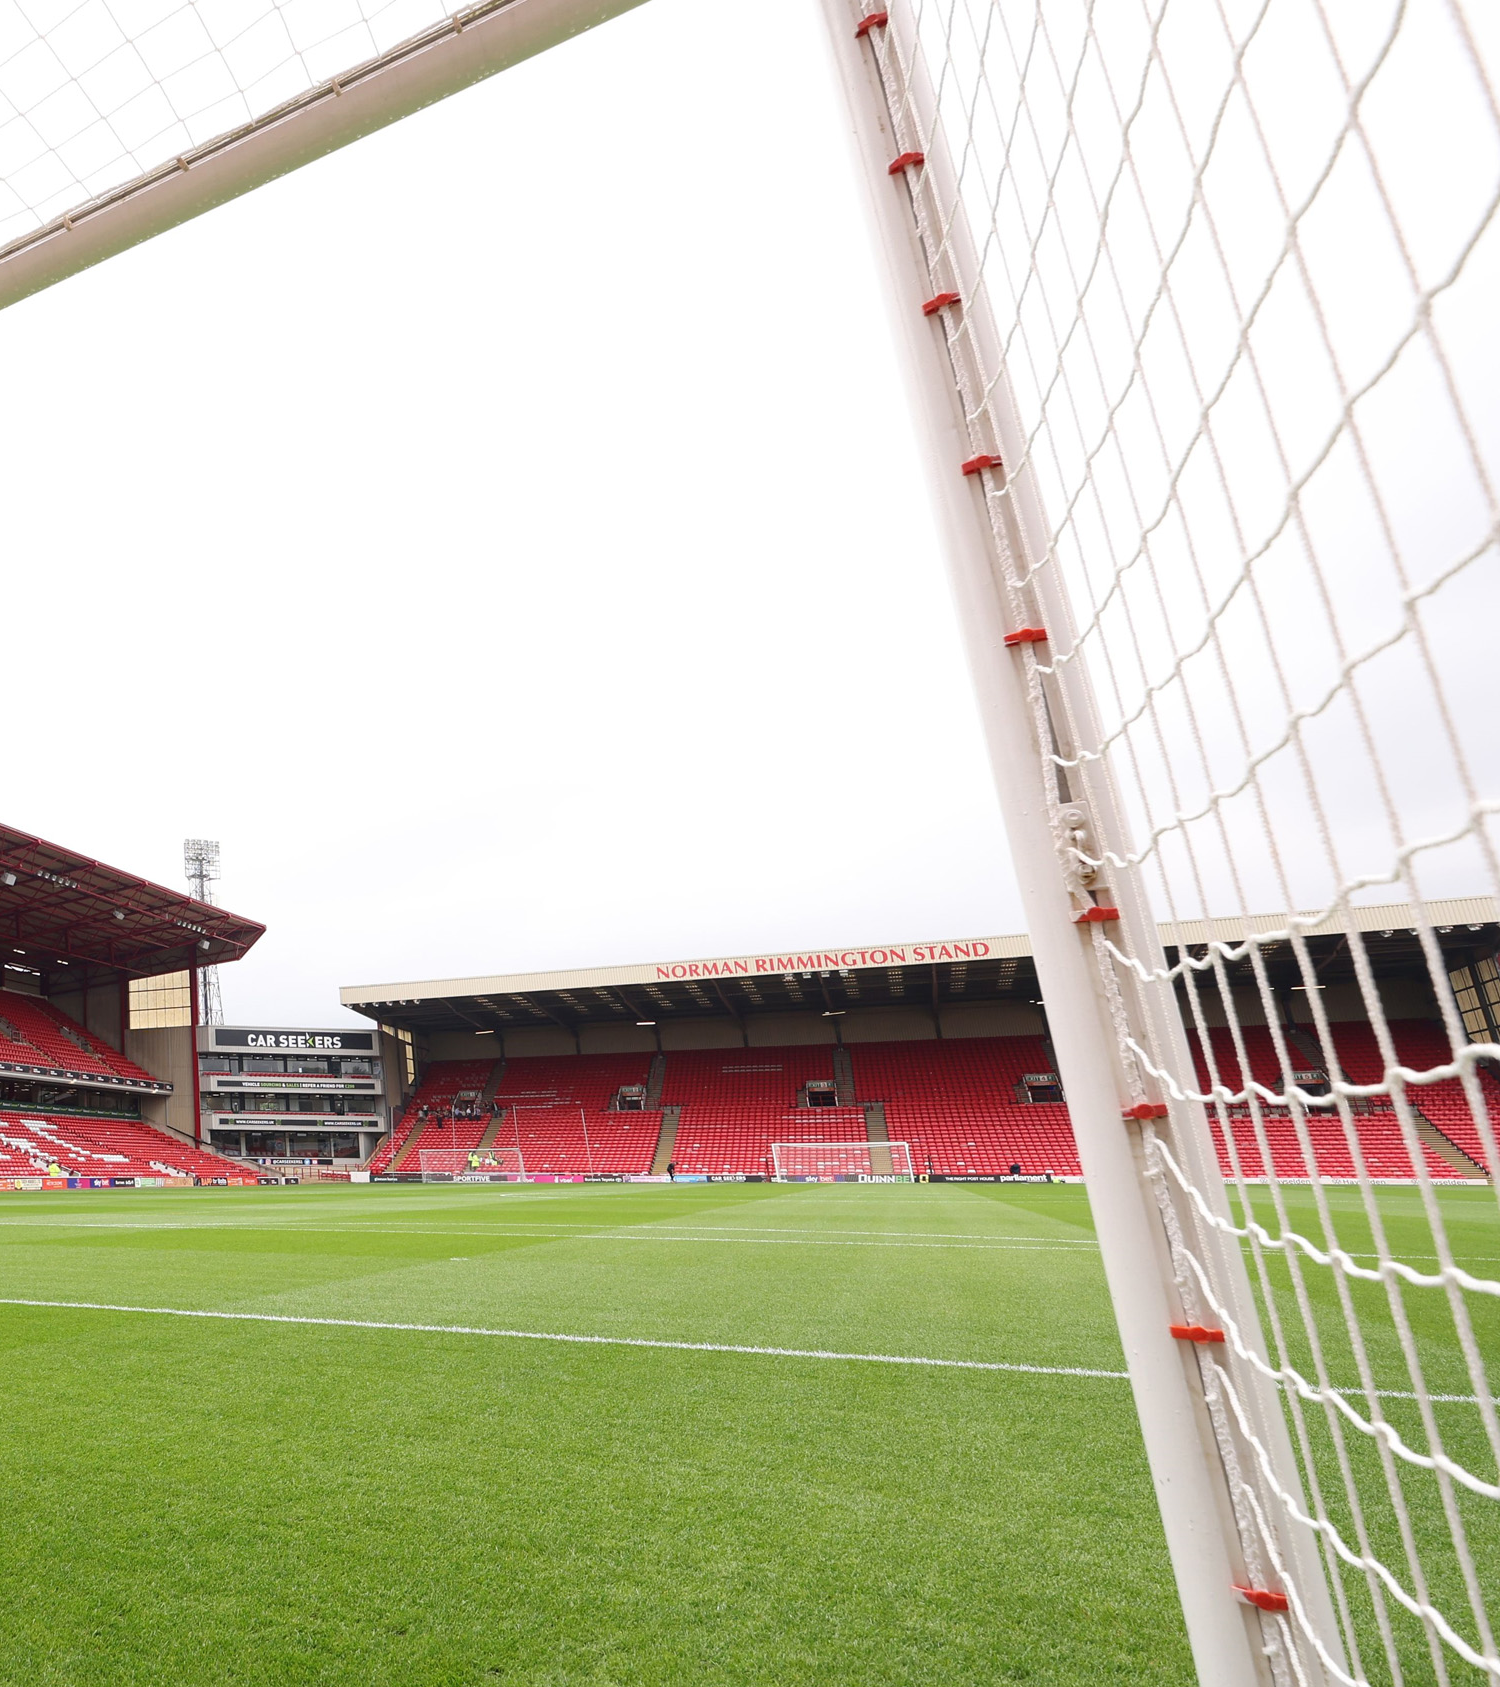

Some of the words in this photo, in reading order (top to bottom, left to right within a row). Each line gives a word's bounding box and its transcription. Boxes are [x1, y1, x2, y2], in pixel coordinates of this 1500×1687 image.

[656, 960, 748, 980] NORMAN
[756, 948, 906, 973] RIMMINGTON
[913, 942, 990, 962] STAND
[247, 1034, 276, 1047] CAR
[279, 1032, 341, 1049] SEEKERS
[1000, 1174, 1047, 1182] parliament
